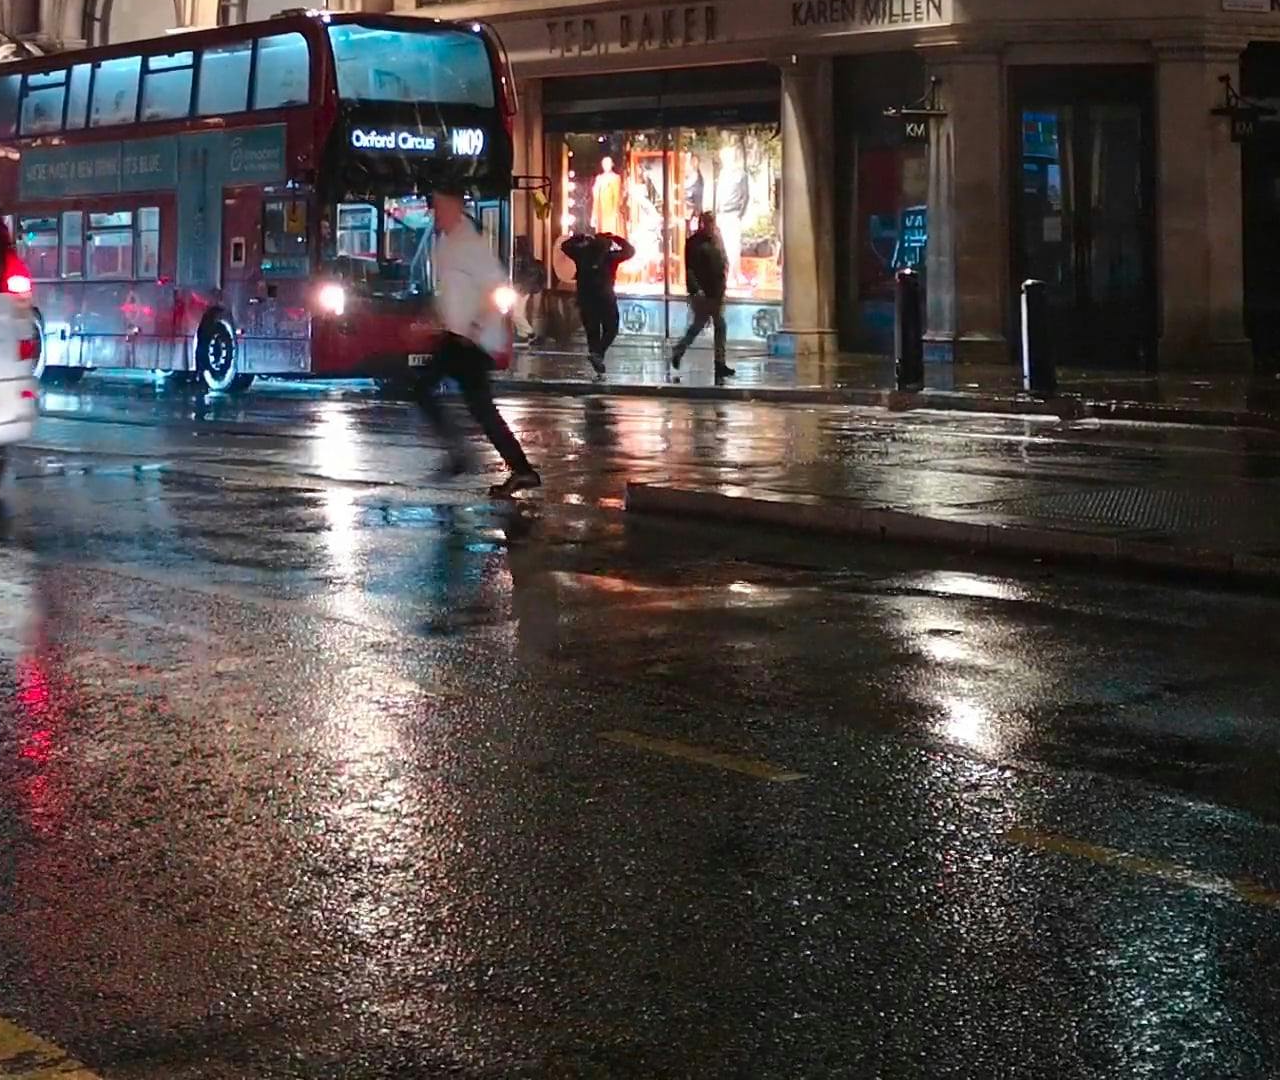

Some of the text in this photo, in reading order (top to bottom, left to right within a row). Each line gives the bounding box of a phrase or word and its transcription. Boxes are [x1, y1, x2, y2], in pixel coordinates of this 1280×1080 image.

[546, 19, 595, 54] TED
[352, 129, 436, 151] Oxford Circus
[452, 128, 484, 155] N109
[906, 123, 926, 137] KM
